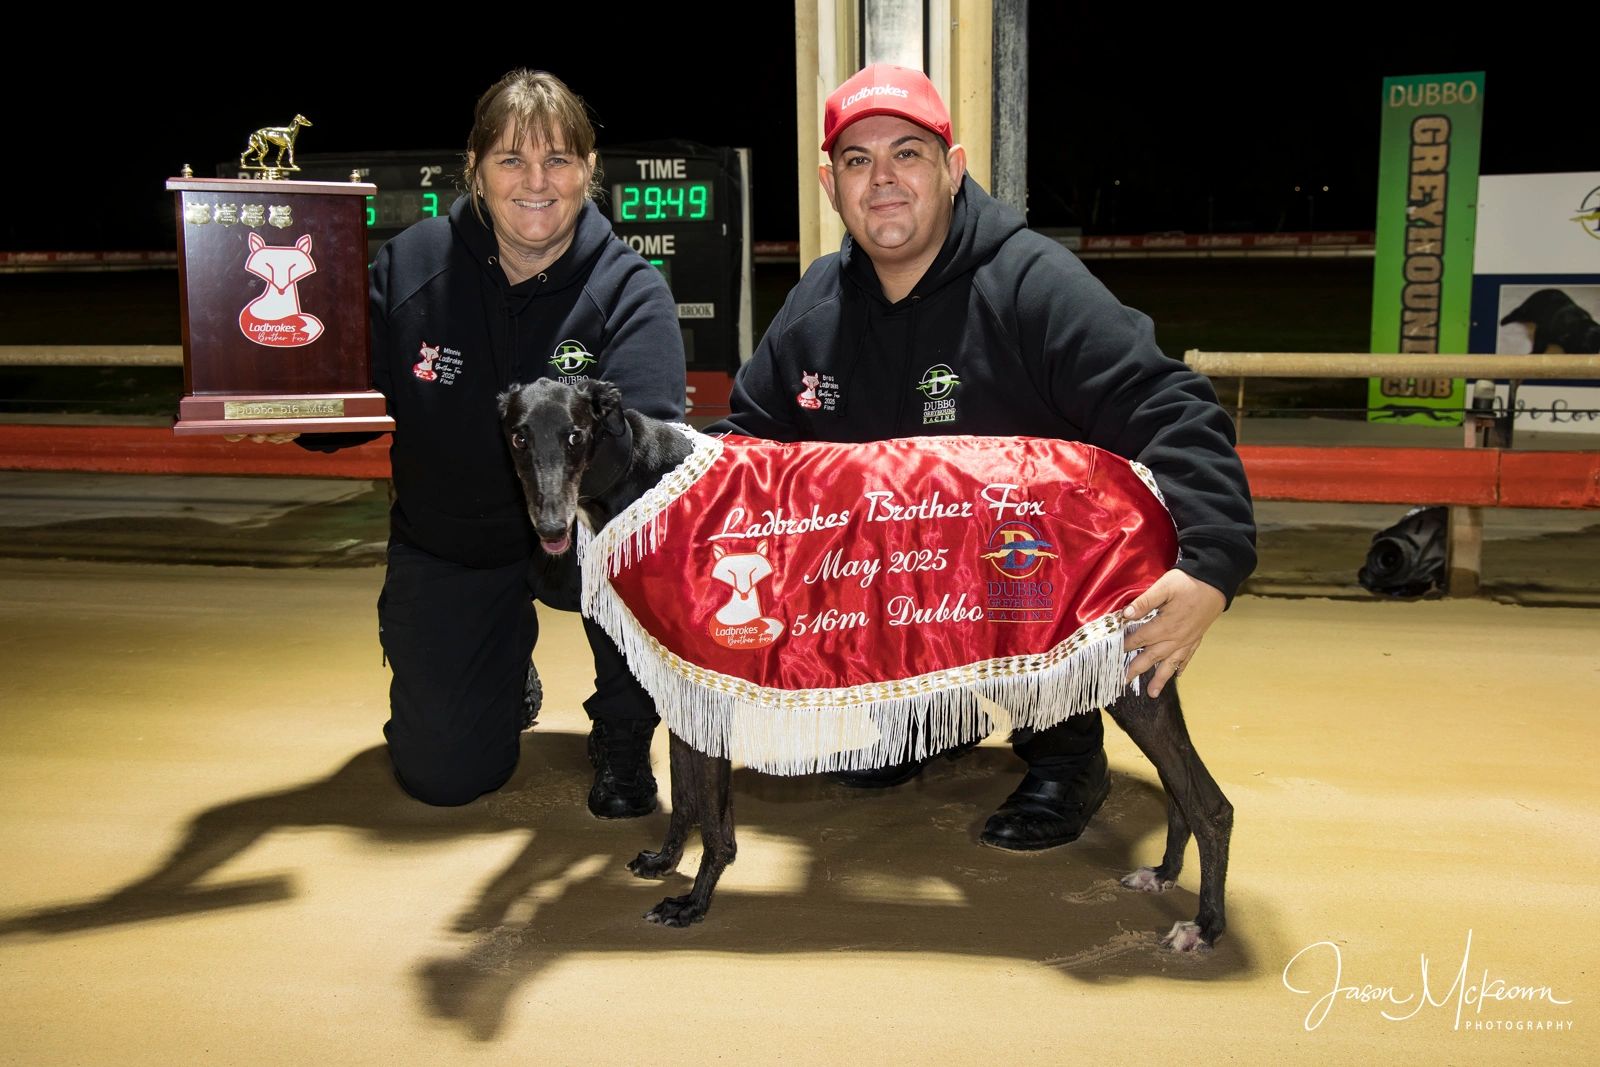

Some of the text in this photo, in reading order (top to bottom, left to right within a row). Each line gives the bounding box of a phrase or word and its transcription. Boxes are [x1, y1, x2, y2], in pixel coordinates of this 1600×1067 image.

[841, 84, 909, 111] Ladbrokes
[1389, 80, 1477, 107] DUBBO
[637, 159, 687, 180] TIME
[680, 304, 712, 316] BROOK
[249, 322, 296, 333] Ladbrokes
[257, 332, 288, 343] Brother
[1381, 376, 1453, 397] CLUB
[237, 405, 334, 415] Dubbo 516 Mtrs
[923, 398, 956, 411] DUBBO
[923, 414, 956, 424] RACING
[707, 483, 1047, 541] Ladbrokes Brother Fox
[803, 547, 949, 588] May 2025
[987, 581, 1053, 597] DUBBO
[988, 598, 1053, 608] GREYHOUND
[792, 592, 984, 636] 516m Dubbo
[987, 611, 1053, 620] RACING
[715, 626, 759, 637] Ladbrokes
